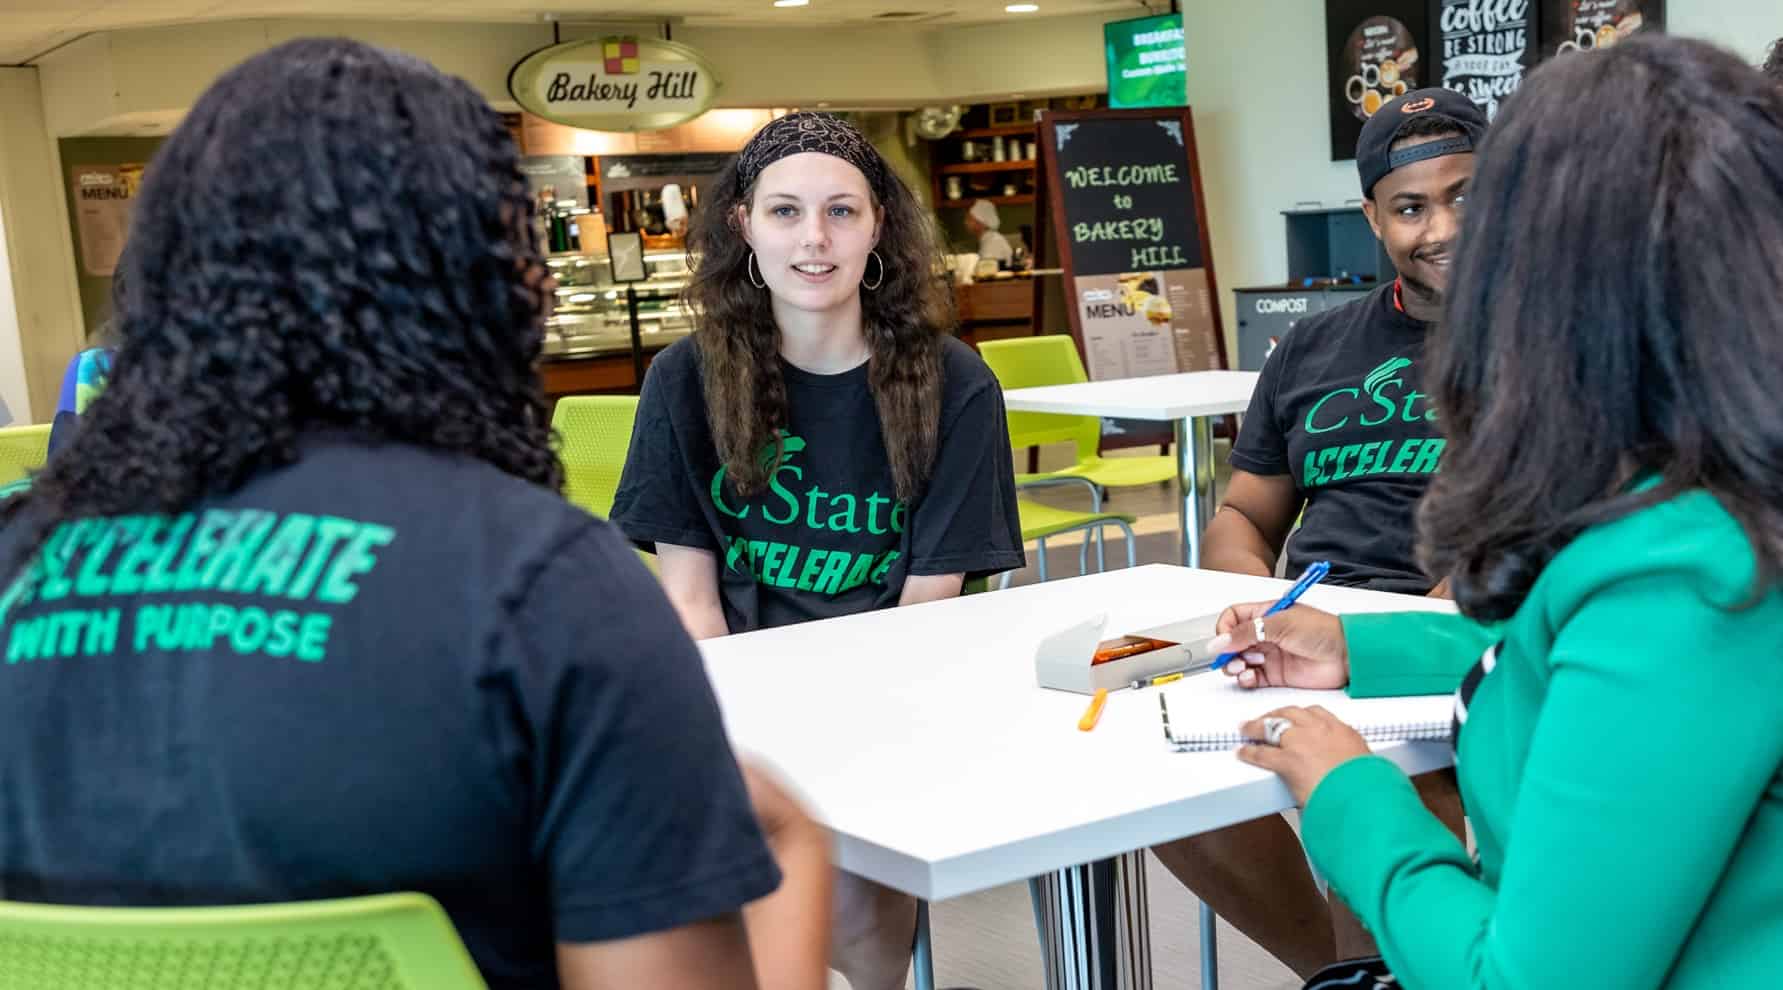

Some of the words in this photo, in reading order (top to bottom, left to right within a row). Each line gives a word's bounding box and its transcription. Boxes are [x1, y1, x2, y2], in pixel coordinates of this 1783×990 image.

[1444, 39, 1461, 59] BE
[1467, 28, 1527, 55] STRONG
[547, 72, 638, 109] Bakery
[646, 71, 698, 99] Hill
[1065, 163, 1180, 189] WELCOME
[81, 187, 129, 201] MENU
[1113, 193, 1133, 210] to
[1073, 217, 1165, 243] BAKERY
[1131, 245, 1188, 269] HILL
[1086, 302, 1136, 319] MENU
[1255, 297, 1309, 315] COMPOST
[1359, 378, 1442, 427] Sta
[1303, 437, 1449, 488] ACCELER
[6, 607, 121, 664] WITH
[134, 602, 333, 662] PURPOSE
